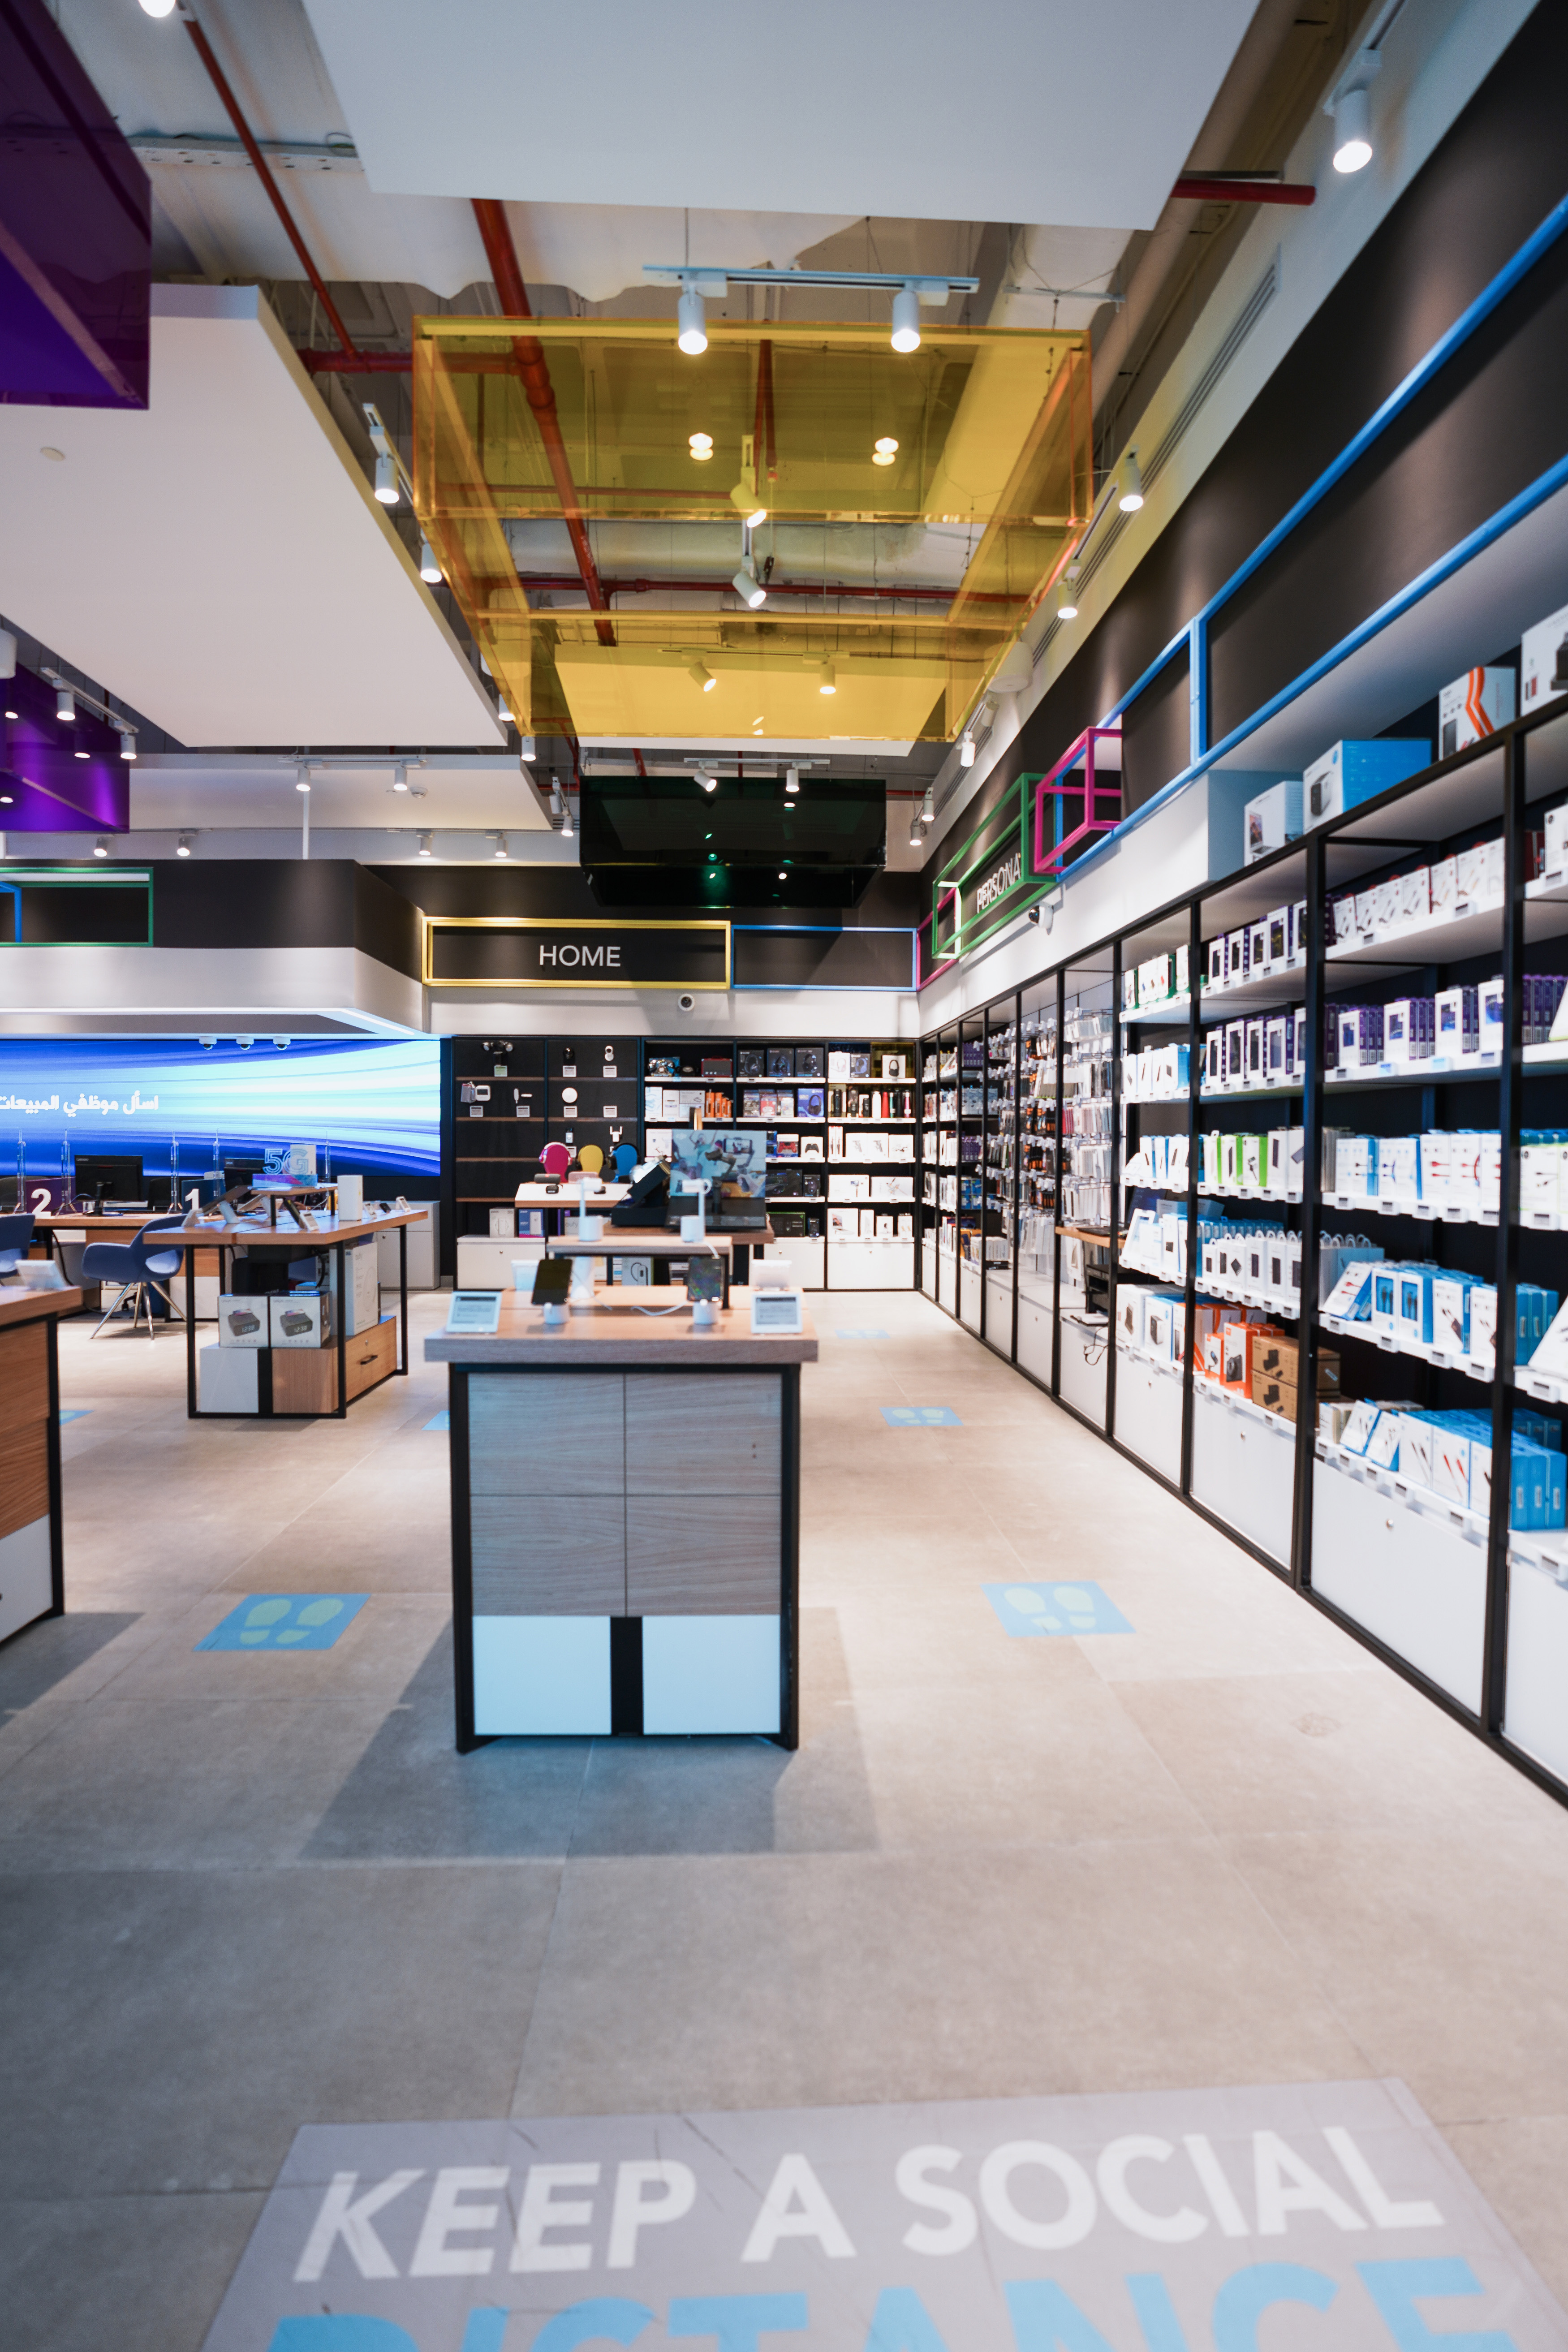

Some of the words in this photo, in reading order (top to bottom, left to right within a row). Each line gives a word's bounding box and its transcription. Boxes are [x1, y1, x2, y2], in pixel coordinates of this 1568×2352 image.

[539, 945, 621, 967] HOME
[0, 1095, 59, 1114] المبيعات
[63, 1093, 119, 1117] موظفي
[122, 1090, 159, 1115] اسأل
[263, 1148, 309, 1175] 5G
[31, 1188, 52, 1219] 2
[185, 1188, 200, 1210] 1
[292, 2160, 697, 2283] KEEP
[740, 2152, 857, 2264] A
[895, 2125, 1445, 2257] SOCIAL
